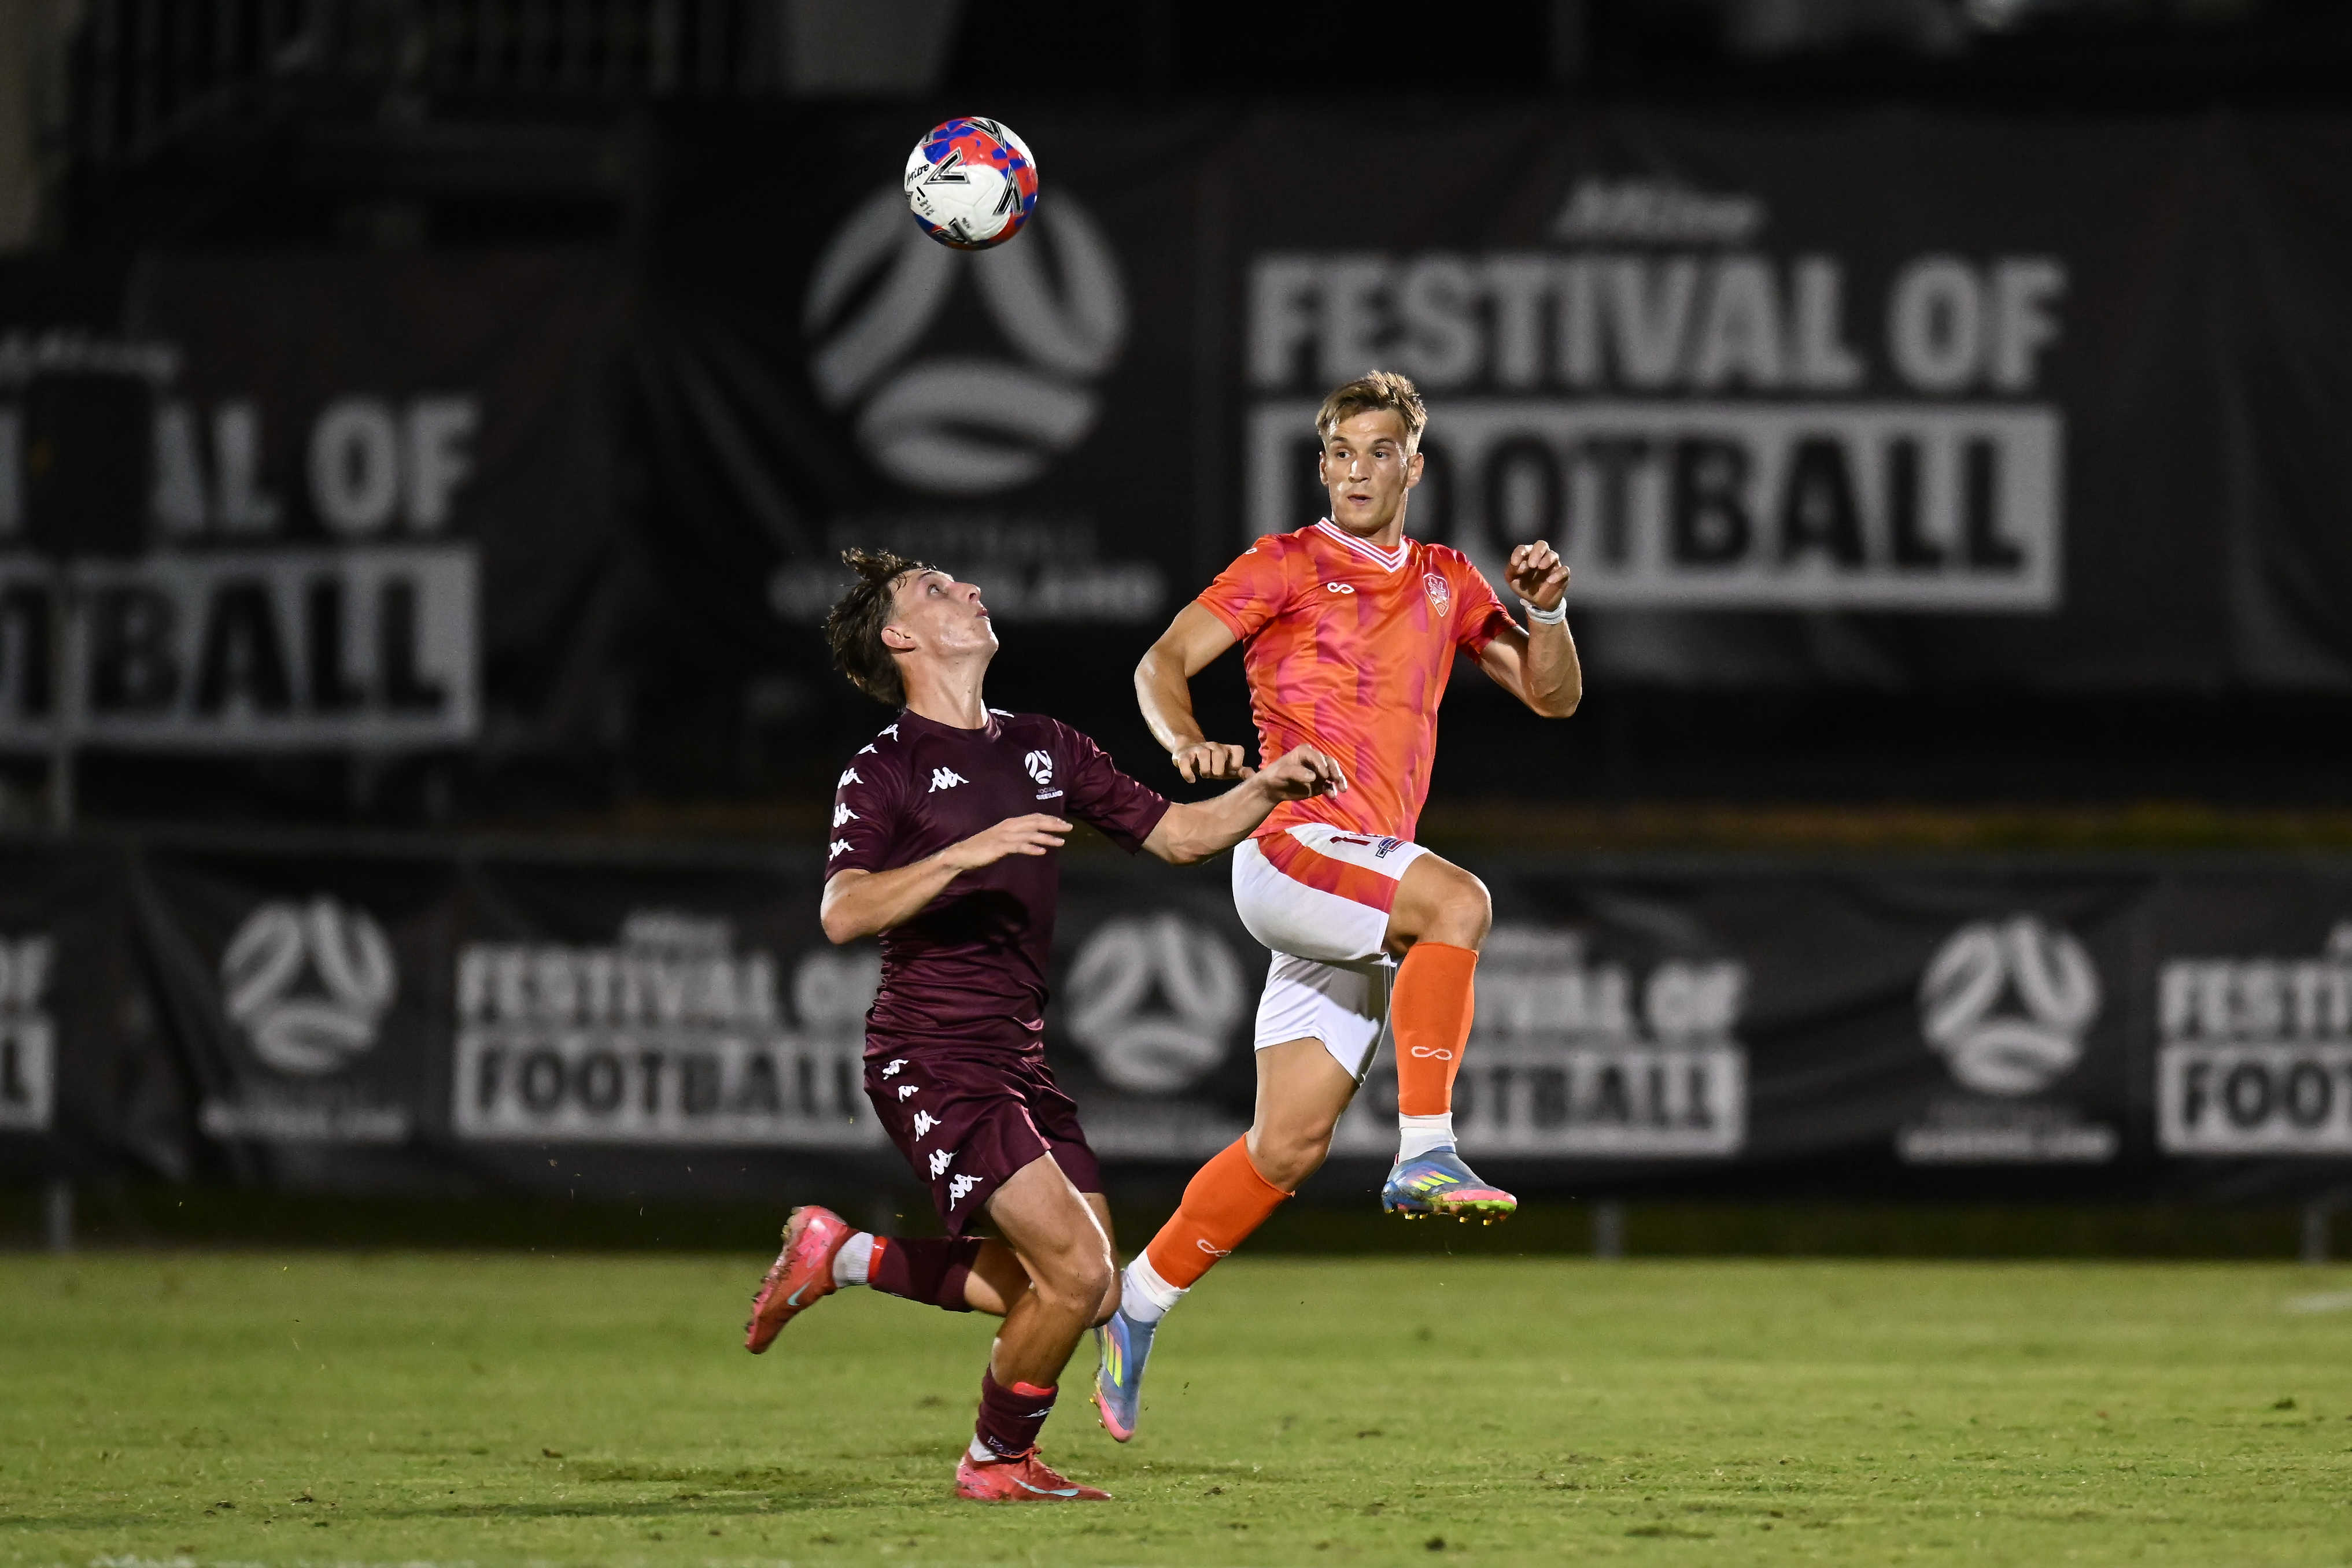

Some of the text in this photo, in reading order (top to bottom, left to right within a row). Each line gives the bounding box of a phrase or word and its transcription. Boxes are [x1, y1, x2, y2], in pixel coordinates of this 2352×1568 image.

[1248, 254, 2067, 391] FESTIVAL OF
[309, 395, 479, 533] OF
[460, 944, 781, 1019] FESTIVAL
[478, 1049, 863, 1115] FOOTBALL
[2185, 1060, 2352, 1130] FOO
